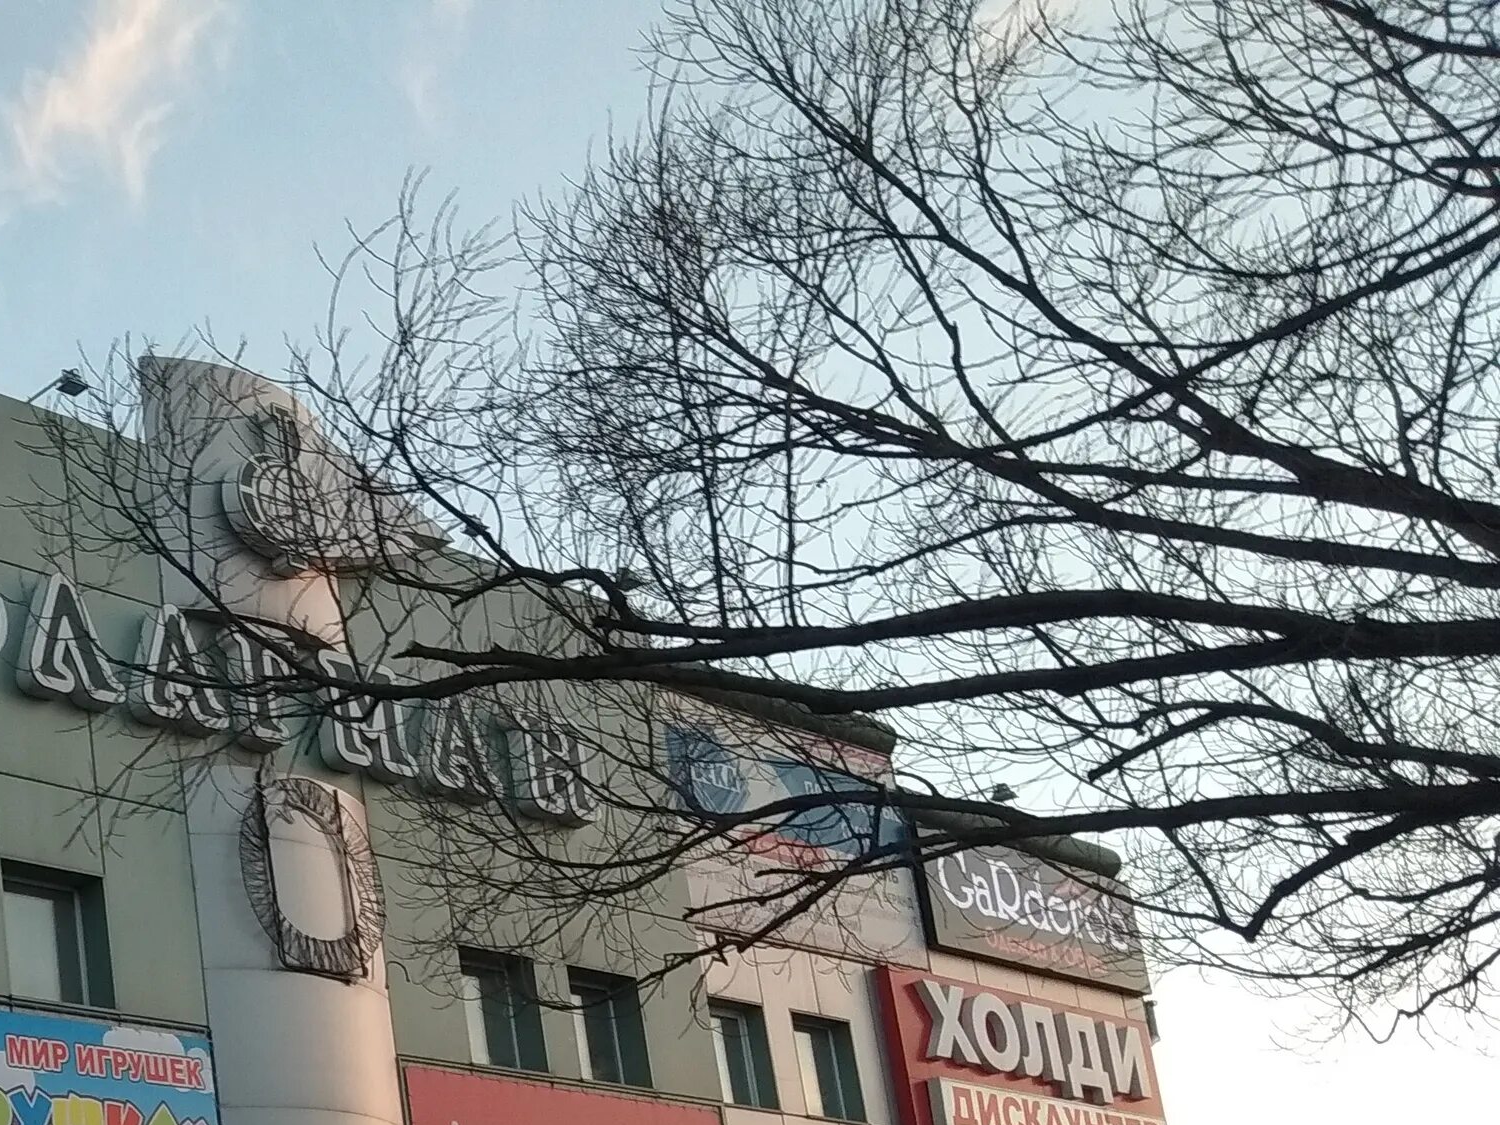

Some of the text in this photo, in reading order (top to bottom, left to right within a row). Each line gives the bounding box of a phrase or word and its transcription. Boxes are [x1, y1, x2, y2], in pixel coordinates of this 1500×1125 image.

[5, 1035, 204, 1088] МИР ИГРУШЕК
[921, 980, 1150, 1102] ХОЛДИ
